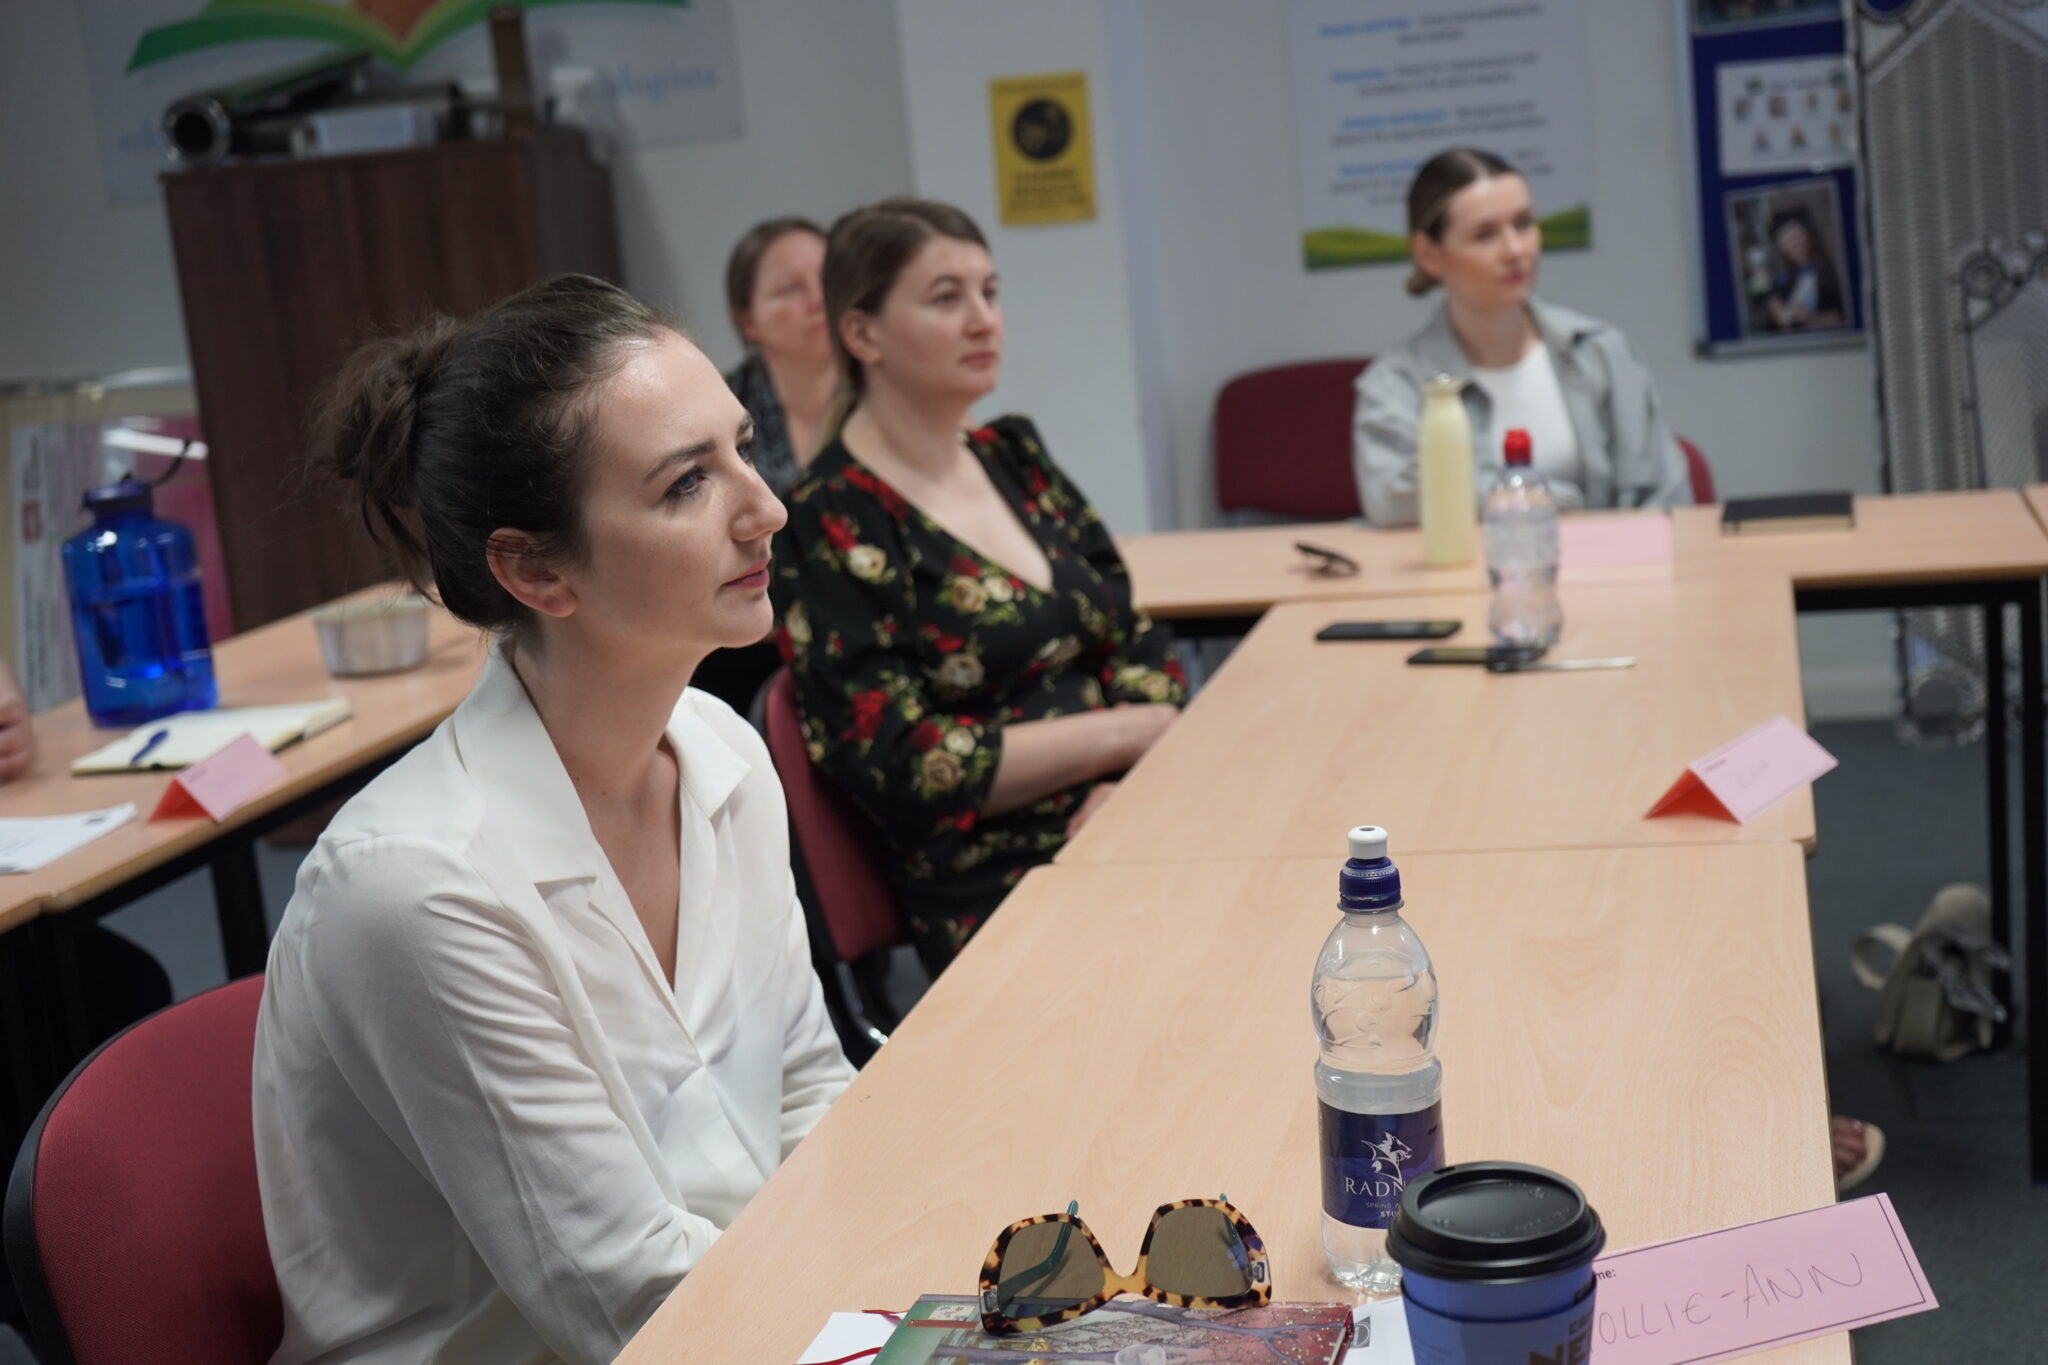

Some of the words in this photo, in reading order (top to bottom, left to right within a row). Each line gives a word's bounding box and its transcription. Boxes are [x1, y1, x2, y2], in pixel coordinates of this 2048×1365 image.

[1345, 1176, 1406, 1198] RADN
[1595, 1268, 1617, 1280] me:
[1592, 1252, 1863, 1351] OLLIE-ANN
